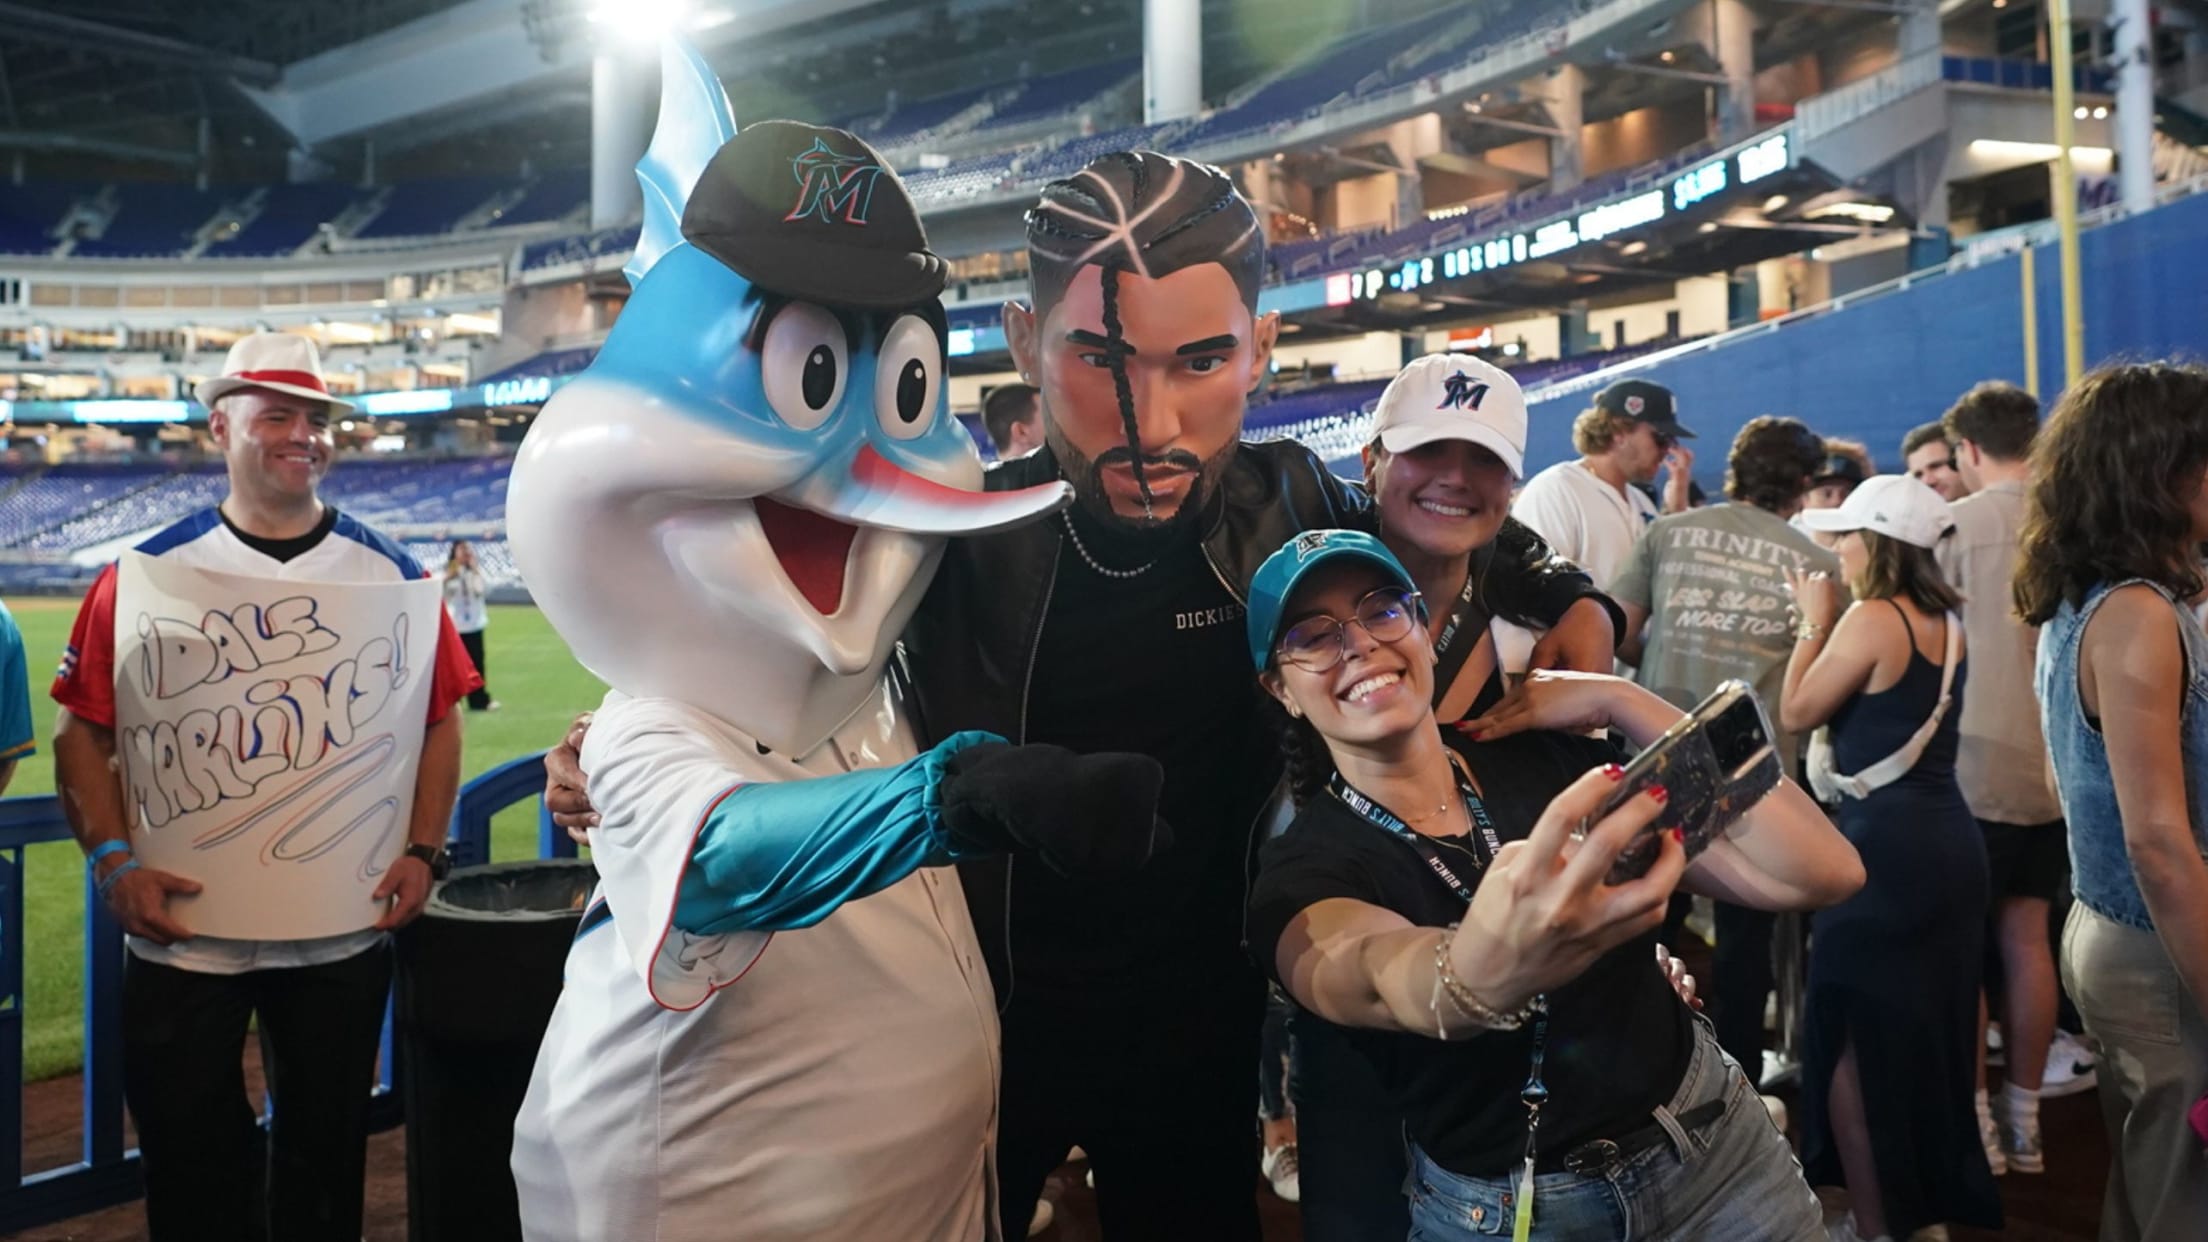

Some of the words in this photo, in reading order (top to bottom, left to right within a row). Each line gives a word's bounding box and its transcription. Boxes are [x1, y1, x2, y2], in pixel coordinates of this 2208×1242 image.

[1668, 526, 1811, 570] TRINITY
[1175, 604, 1244, 629] DICKIES
[1675, 610, 1740, 632] MORE
[1740, 614, 1787, 636] TOP
[1341, 784, 1373, 815] BUNCH
[1481, 827, 1502, 859] BUNC
[1428, 854, 1463, 890] BUNCH
